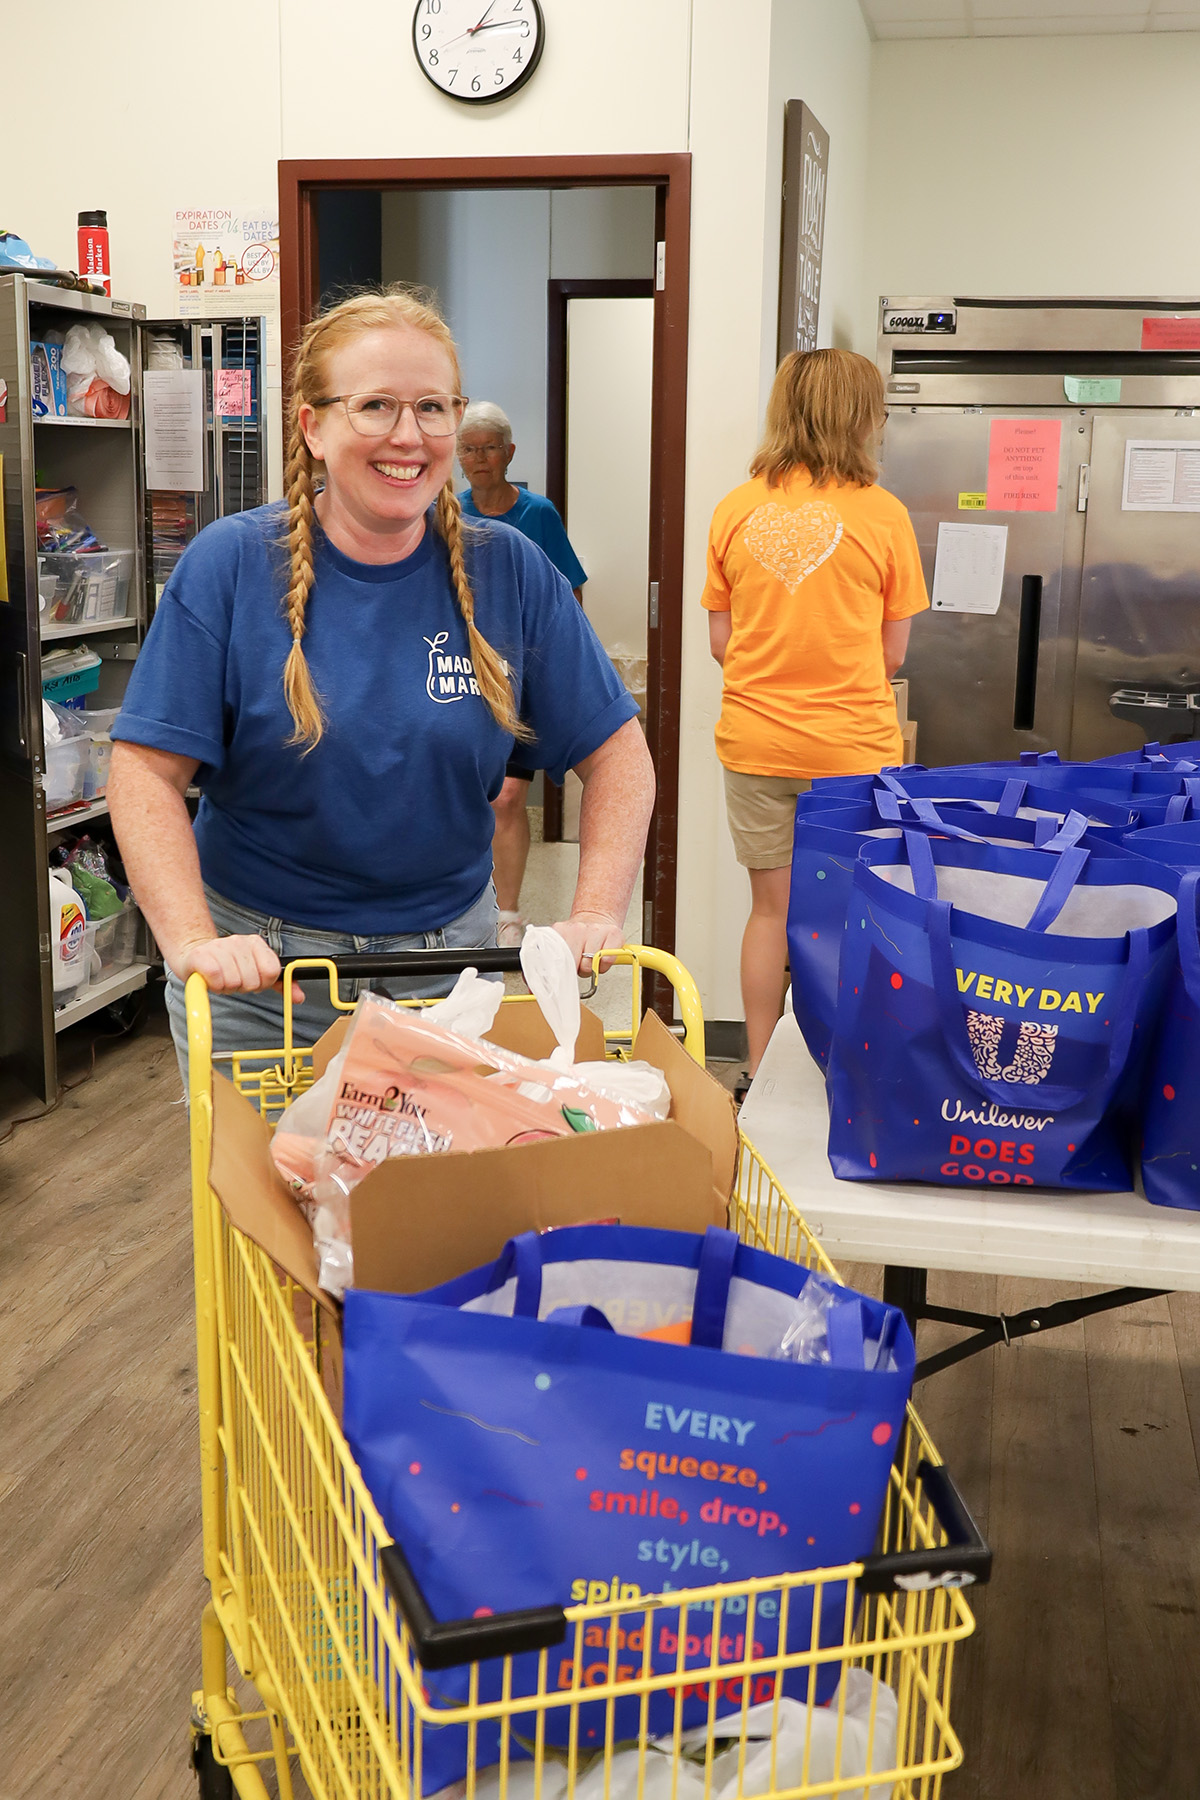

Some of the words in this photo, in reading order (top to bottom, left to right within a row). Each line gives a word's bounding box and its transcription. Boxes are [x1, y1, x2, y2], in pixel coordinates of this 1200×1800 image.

[421, 24, 432, 41] 9
[520, 20, 531, 38] 3
[428, 48, 439, 66] 8
[512, 46, 523, 64] 4
[448, 69, 459, 87] 7
[471, 74, 481, 92] 6
[494, 68, 504, 85] 5
[175, 210, 232, 220] EXPIRATION
[189, 220, 219, 230] DATES
[242, 221, 259, 231] EAT
[261, 221, 274, 231] BY
[243, 231, 273, 241] DATES
[86, 238, 95, 274] Madison
[95, 244, 104, 274] Market
[889, 317, 924, 327] 6000XL
[437, 656, 508, 677] MADN
[955, 968, 1034, 1008] VERY
[1038, 989, 1105, 1014] DAY
[336, 1104, 397, 1136] WHITE
[941, 1098, 1055, 1132] Unilever
[949, 1134, 1035, 1166] DOES
[940, 1161, 1035, 1185] GOOD
[644, 1401, 756, 1446] EVERY
[619, 1448, 768, 1494] squeeze,
[588, 1488, 689, 1525] smile,
[700, 1496, 788, 1537] drop,
[637, 1537, 730, 1575] style,
[584, 1624, 648, 1652] and
